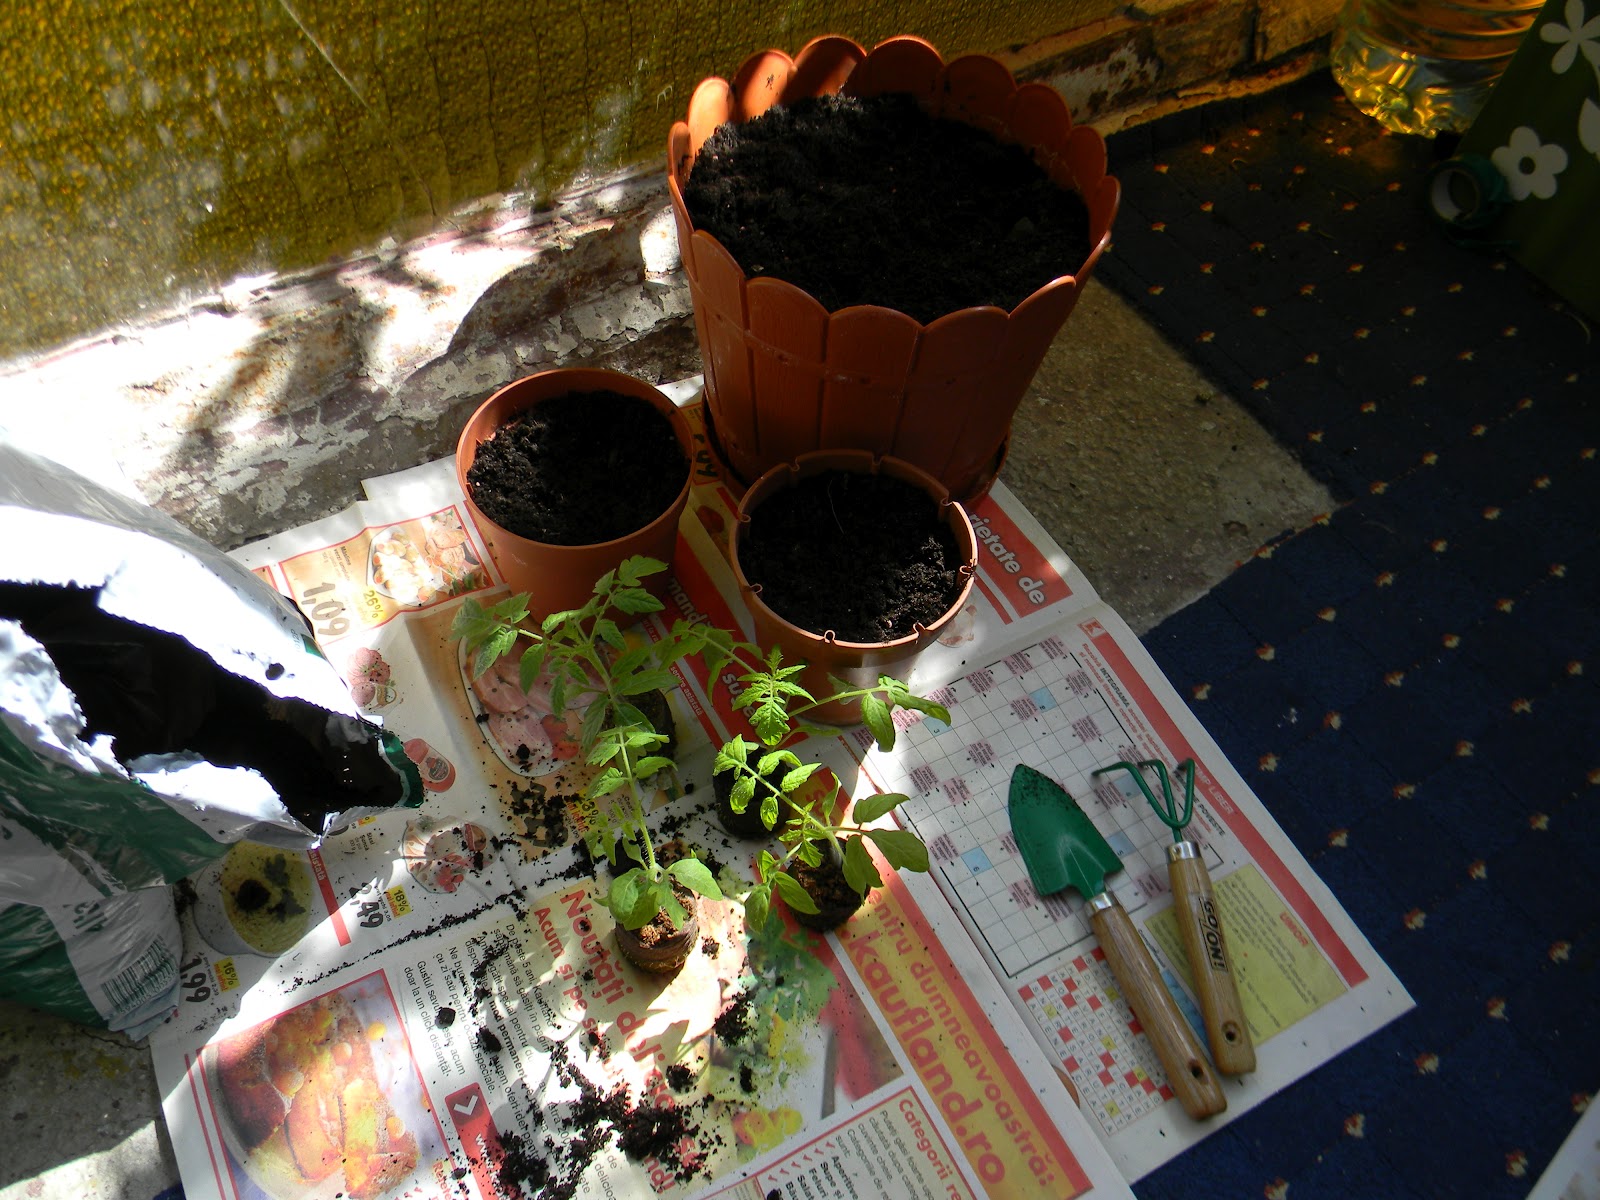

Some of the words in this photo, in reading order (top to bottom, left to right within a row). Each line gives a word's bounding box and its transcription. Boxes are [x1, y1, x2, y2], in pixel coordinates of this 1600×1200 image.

[965, 513, 1020, 573] rietate
[1018, 576, 1045, 604] de
[301, 581, 347, 636] 1,09
[360, 589, 384, 618] 26%
[1099, 667, 1130, 708] INTEGRAMA
[1198, 803, 1225, 836] POVESTE
[1208, 786, 1234, 814] LIBER
[348, 881, 384, 928] 2,49
[393, 889, 409, 912] 18%
[546, 890, 633, 1003] Noutăți
[1199, 898, 1228, 973] GO/ON!
[1279, 912, 1309, 946] UMOR
[435, 952, 445, 964] cu
[439, 964, 449, 973] zi
[448, 946, 458, 960] Ne
[505, 923, 516, 936] De
[524, 968, 538, 985] ani,
[533, 907, 572, 959] Acum
[563, 984, 588, 1015] pe
[178, 954, 211, 1003] 1,99
[222, 961, 237, 985] 16%
[403, 966, 417, 986] doar
[411, 986, 420, 997] la
[414, 996, 425, 1010] un
[416, 960, 434, 989] Gustul
[450, 1049, 465, 1075] acum
[449, 992, 466, 1020] pentru
[495, 984, 517, 1017] special
[509, 1016, 529, 1048] pentru
[512, 975, 524, 987] să
[528, 1011, 538, 1023] în
[420, 1010, 435, 1032] click
[488, 999, 504, 1023] mod
[496, 1023, 527, 1080] permanent
[863, 884, 912, 955] entru
[910, 953, 1054, 1185] dumneavoastră:
[835, 907, 1007, 1184] .kaufland.ro
[473, 1051, 495, 1094] speciale.
[834, 1134, 851, 1158] sunt:
[857, 1122, 879, 1155] cuvinte
[876, 1155, 894, 1183] cheie.
[898, 1098, 953, 1180] Categorii
[606, 1155, 618, 1169] de
[819, 1161, 837, 1187] Supe
[831, 1155, 859, 1200] Aperitive
[906, 1155, 925, 1184] foarte
[808, 1167, 829, 1198] Feluri
[872, 1177, 883, 1190] de
